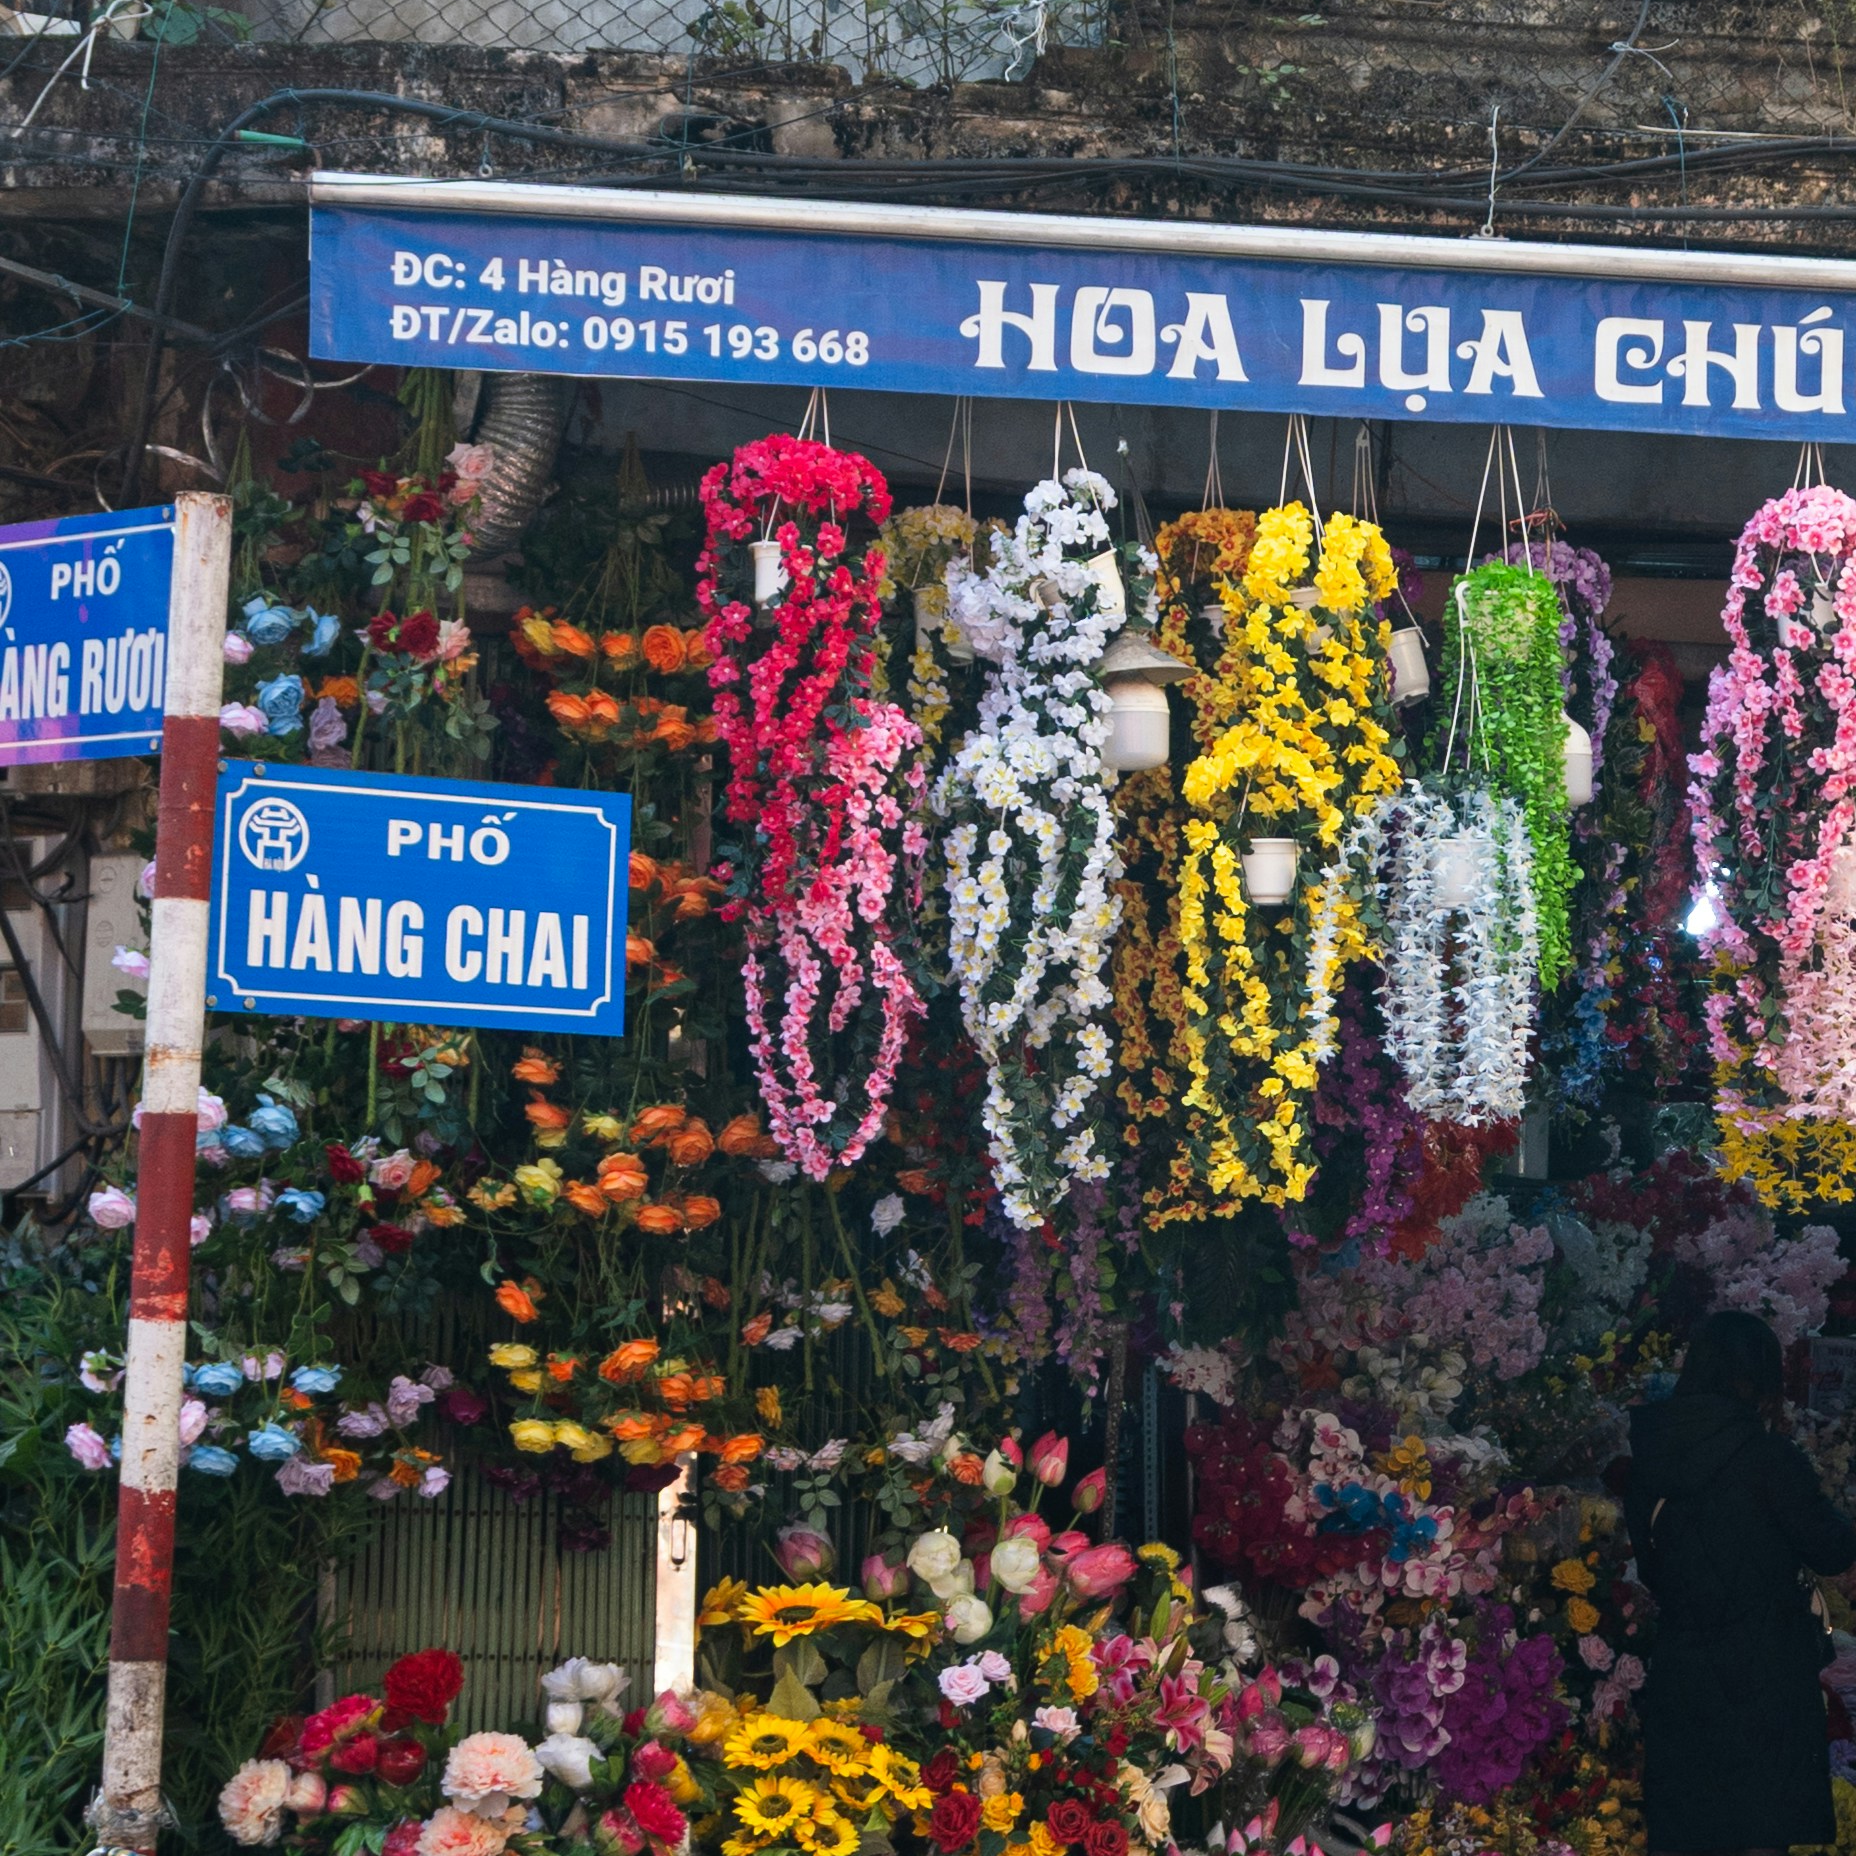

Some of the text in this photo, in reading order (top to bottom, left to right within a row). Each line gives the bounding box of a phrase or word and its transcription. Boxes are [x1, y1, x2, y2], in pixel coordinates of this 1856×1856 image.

[391, 251, 735, 306] ĐC: 4 Hàng Rươi
[389, 305, 870, 366] ĐT/Zalo: 0915 193 668
[959, 279, 1250, 384] HOA
[51, 538, 125, 601] PHỐ
[0, 627, 165, 721] ÀNG RƯƠI
[387, 811, 518, 866] PHỐ
[246, 873, 590, 991] HÀNG CHAI
